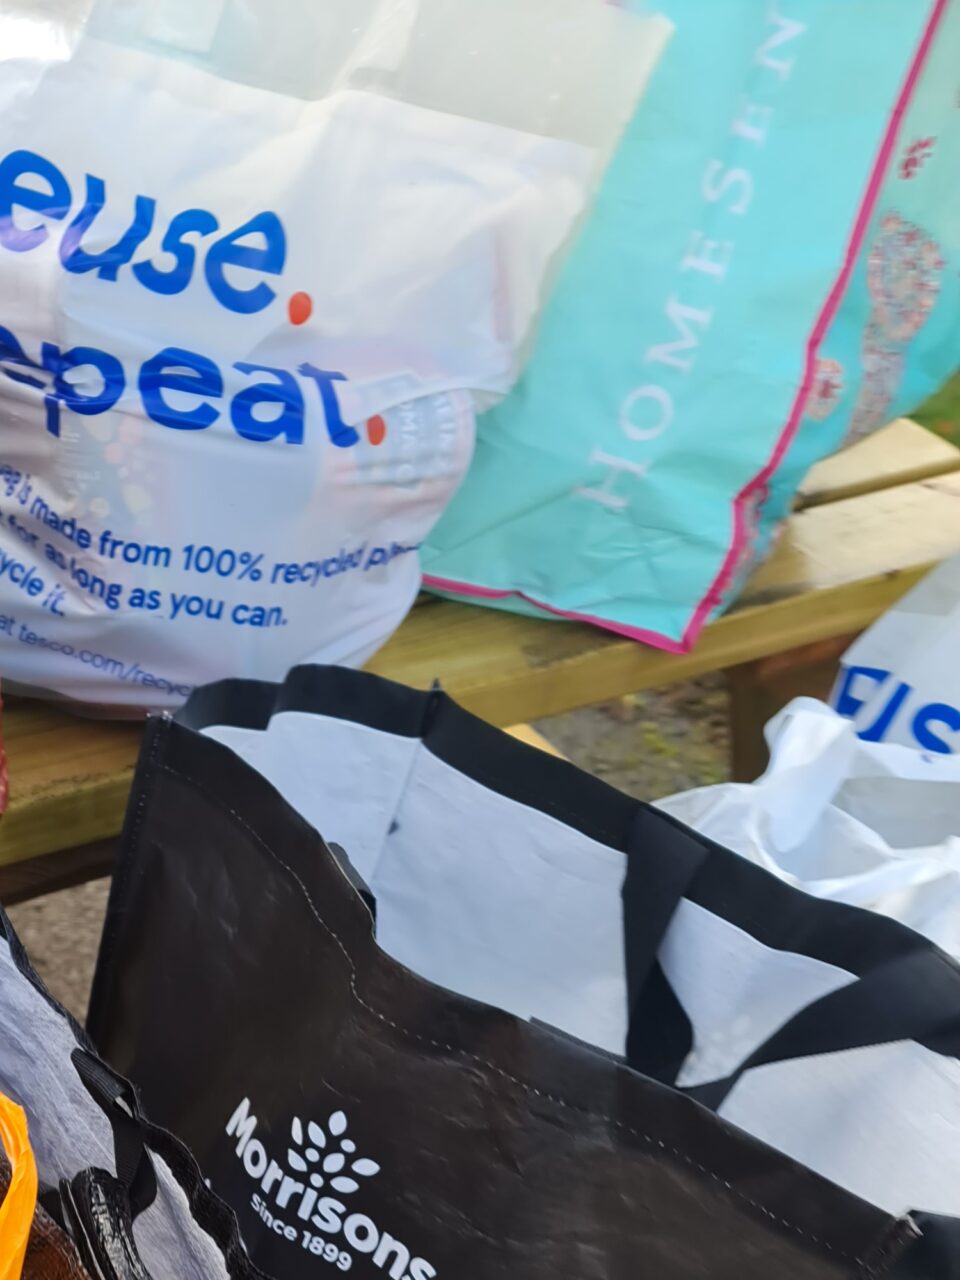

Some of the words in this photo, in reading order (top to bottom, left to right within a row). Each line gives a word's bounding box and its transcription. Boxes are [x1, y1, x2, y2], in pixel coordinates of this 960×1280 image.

[30, 496, 92, 549] made
[99, 530, 172, 568] from
[184, 543, 264, 583] 100%
[70, 556, 122, 611] long
[127, 586, 162, 611] as
[169, 592, 224, 620] you
[231, 603, 289, 628] can.
[250, 1192, 298, 1242] Since
[300, 1229, 353, 1272] 1899
